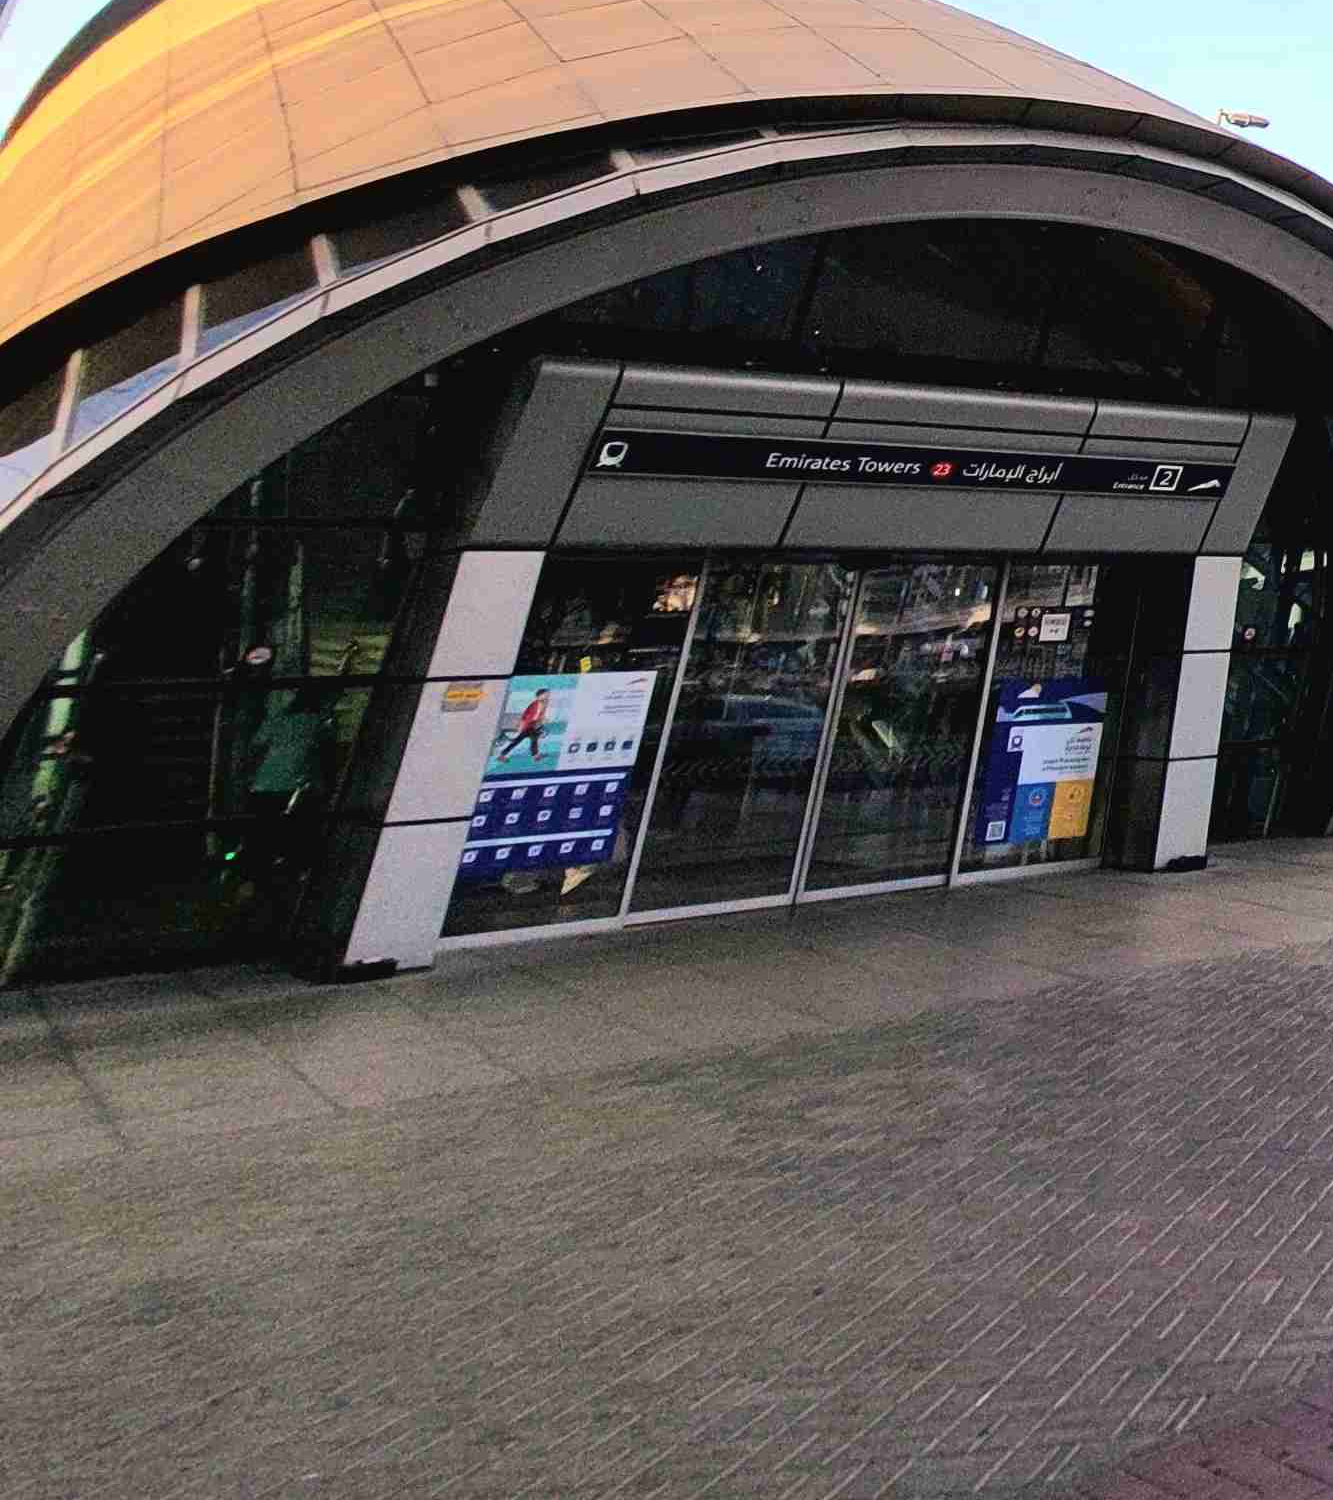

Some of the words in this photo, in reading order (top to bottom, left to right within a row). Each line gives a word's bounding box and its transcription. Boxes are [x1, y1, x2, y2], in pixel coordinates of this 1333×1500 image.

[765, 452, 851, 472] Emirates
[857, 457, 921, 475] Towers
[932, 463, 953, 476] 23
[962, 462, 1025, 482] الإمارات
[1025, 462, 1064, 483] أبراج
[1159, 470, 1173, 486] 2
